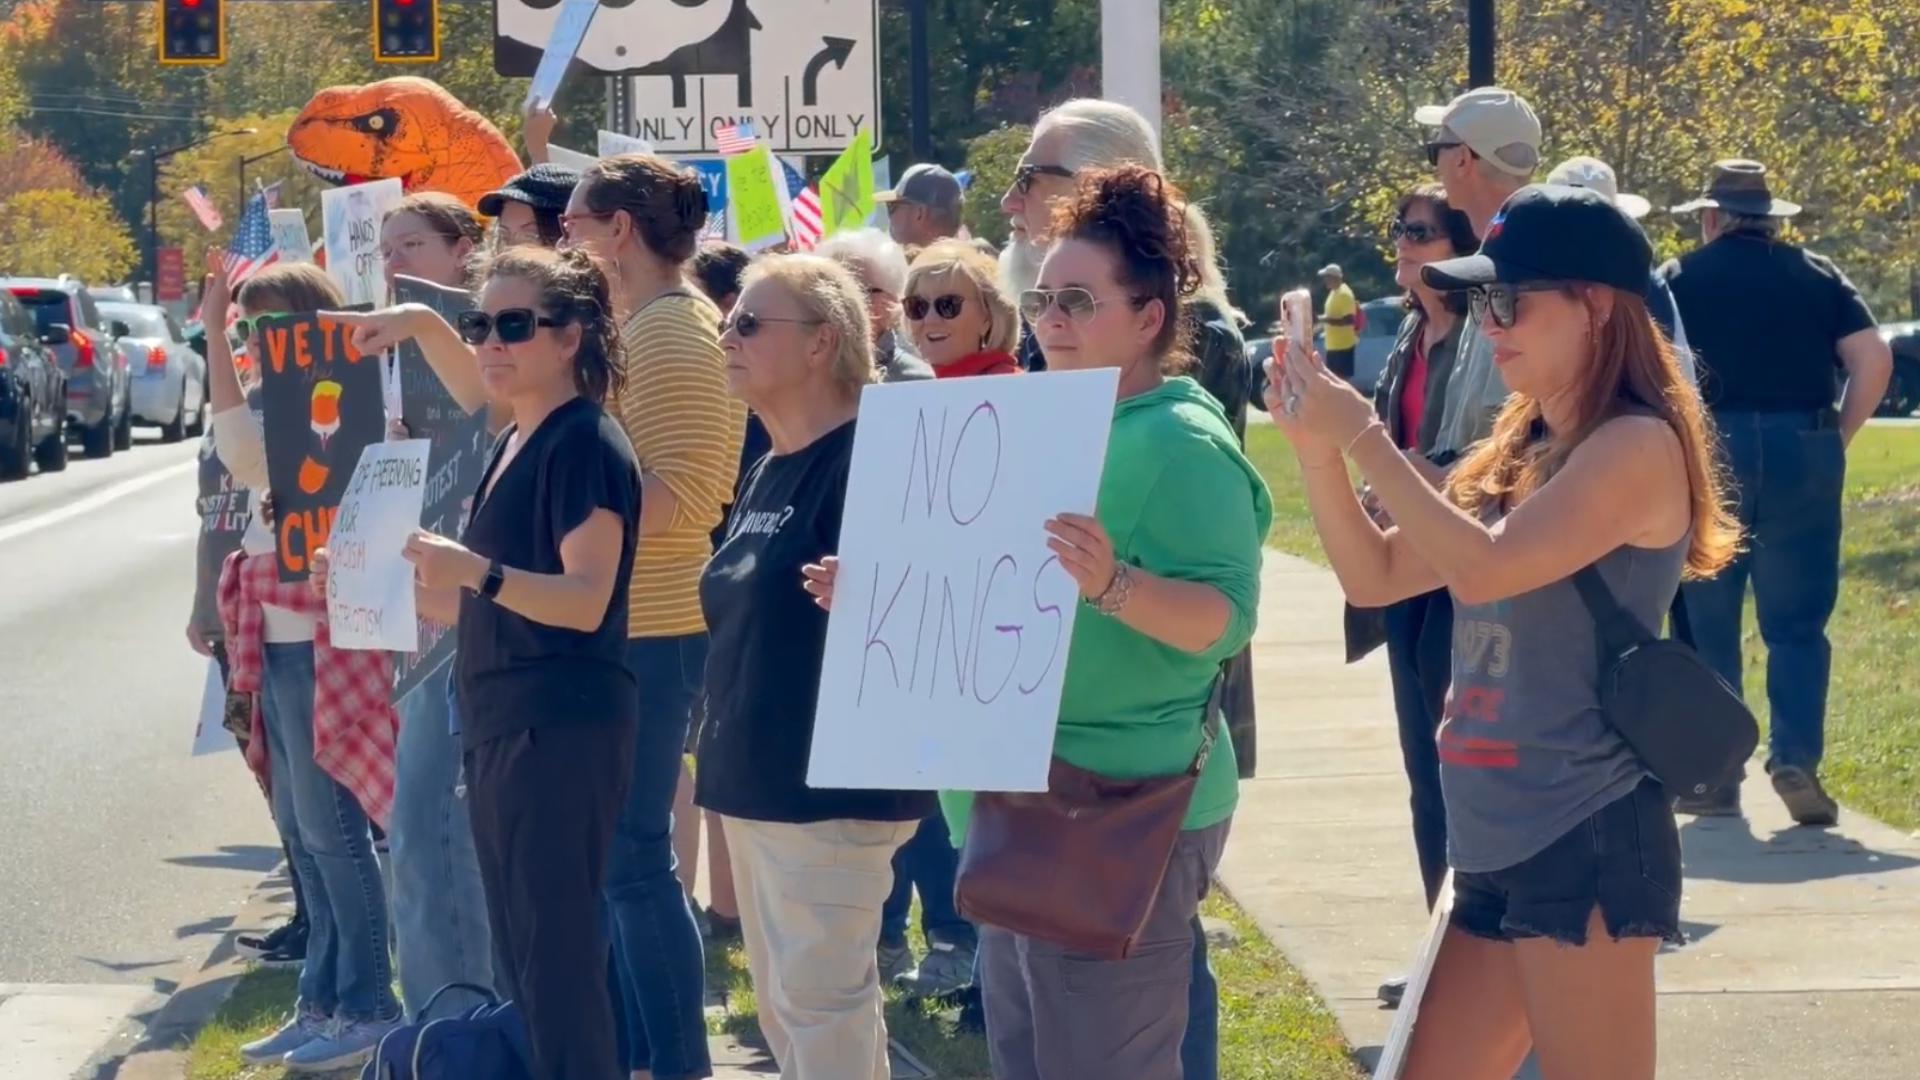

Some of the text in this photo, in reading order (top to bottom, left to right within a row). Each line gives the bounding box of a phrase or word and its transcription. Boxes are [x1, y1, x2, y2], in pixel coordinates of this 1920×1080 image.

[795, 114, 864, 138] ONLY
[902, 400, 1000, 525] NO
[280, 506, 340, 573] CH
[858, 554, 1062, 707] KINGS
